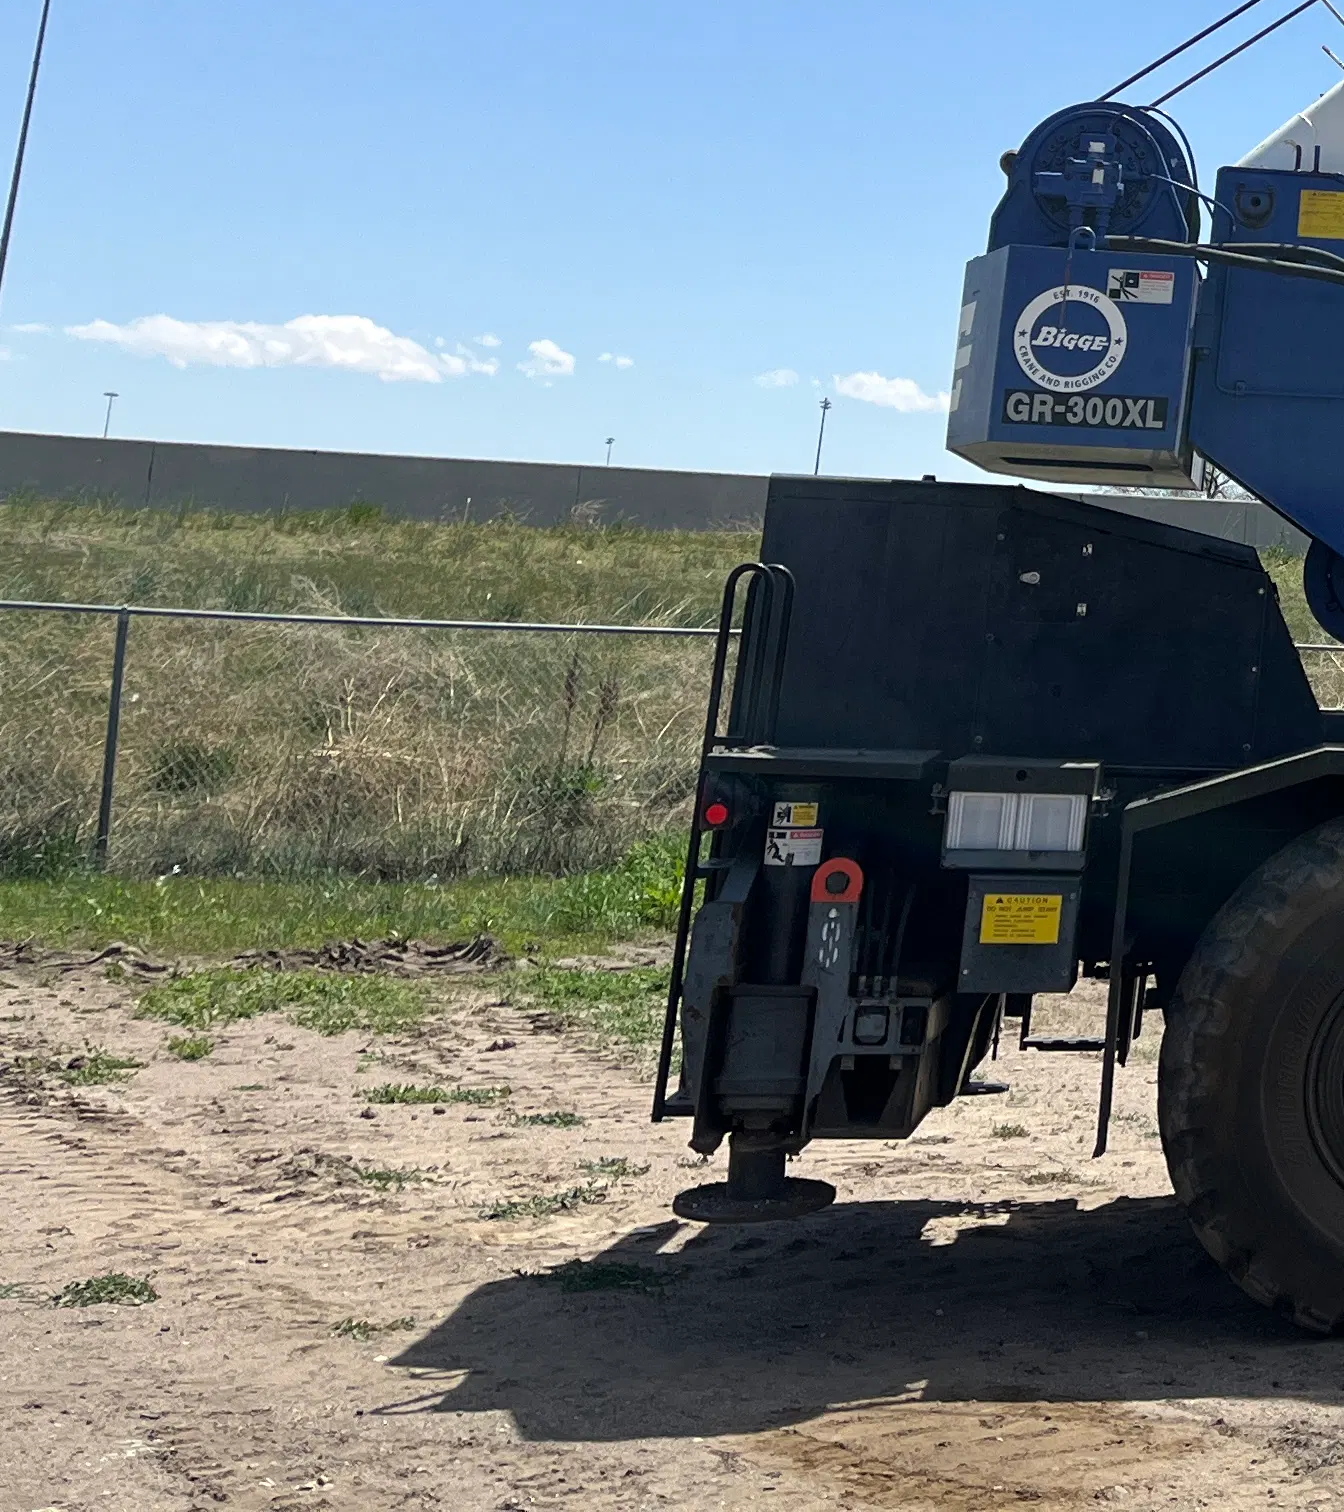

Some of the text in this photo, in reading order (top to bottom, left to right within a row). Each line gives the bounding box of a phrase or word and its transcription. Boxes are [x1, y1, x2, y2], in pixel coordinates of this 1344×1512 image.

[1053, 288, 1101, 304] EST. 1916
[1018, 345, 1040, 376] CRANE
[1038, 375, 1061, 388] AND
[1064, 368, 1106, 389] RIGGING
[1006, 391, 1164, 429] GR-300XL
